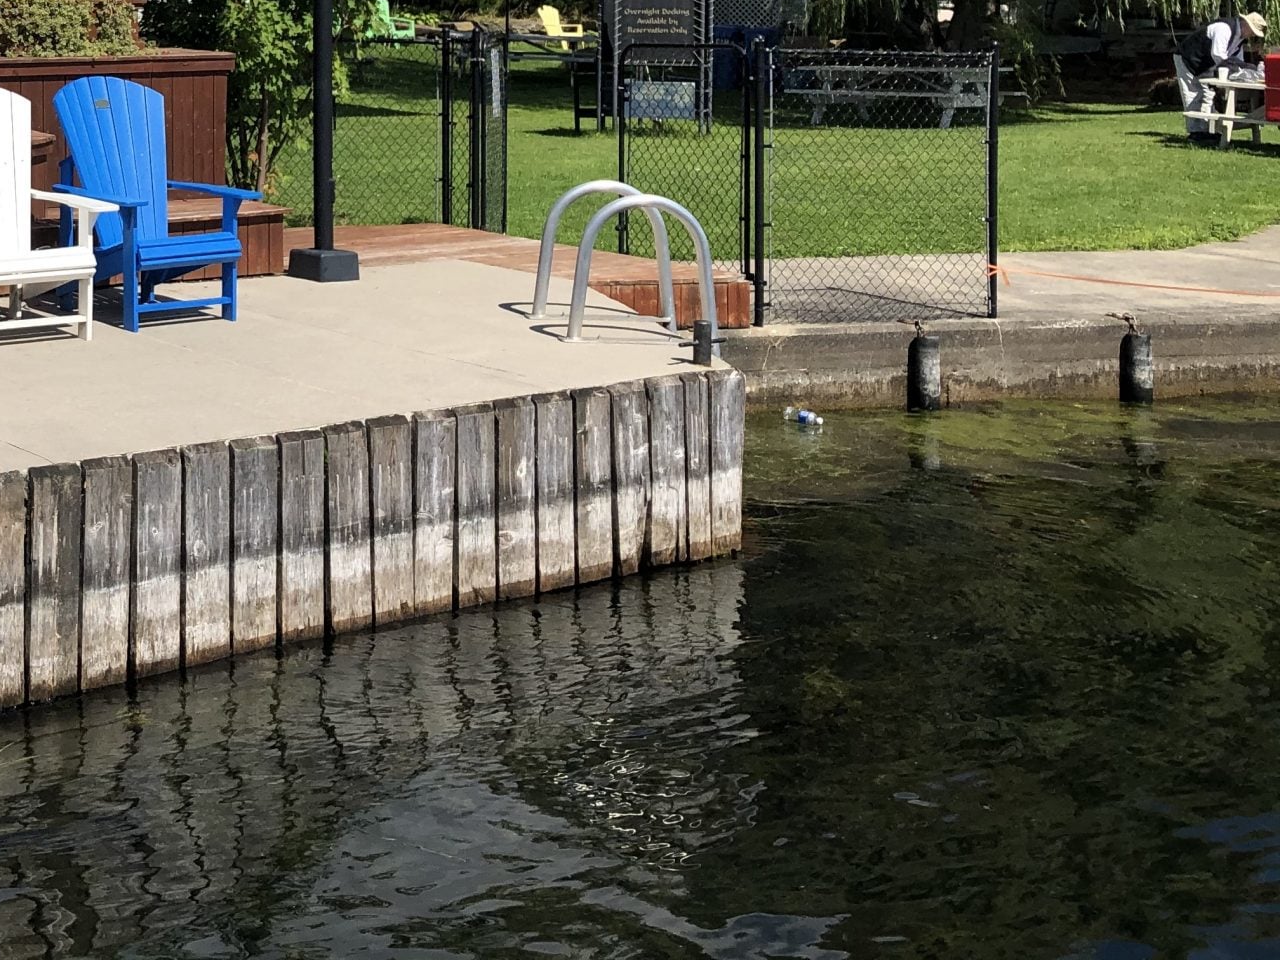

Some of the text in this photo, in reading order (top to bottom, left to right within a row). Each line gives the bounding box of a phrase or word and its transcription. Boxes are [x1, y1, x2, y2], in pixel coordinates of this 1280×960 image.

[624, 7, 690, 17] Overnight Docking
[637, 17, 679, 26] Available by
[627, 26, 688, 35] Reservation Only
